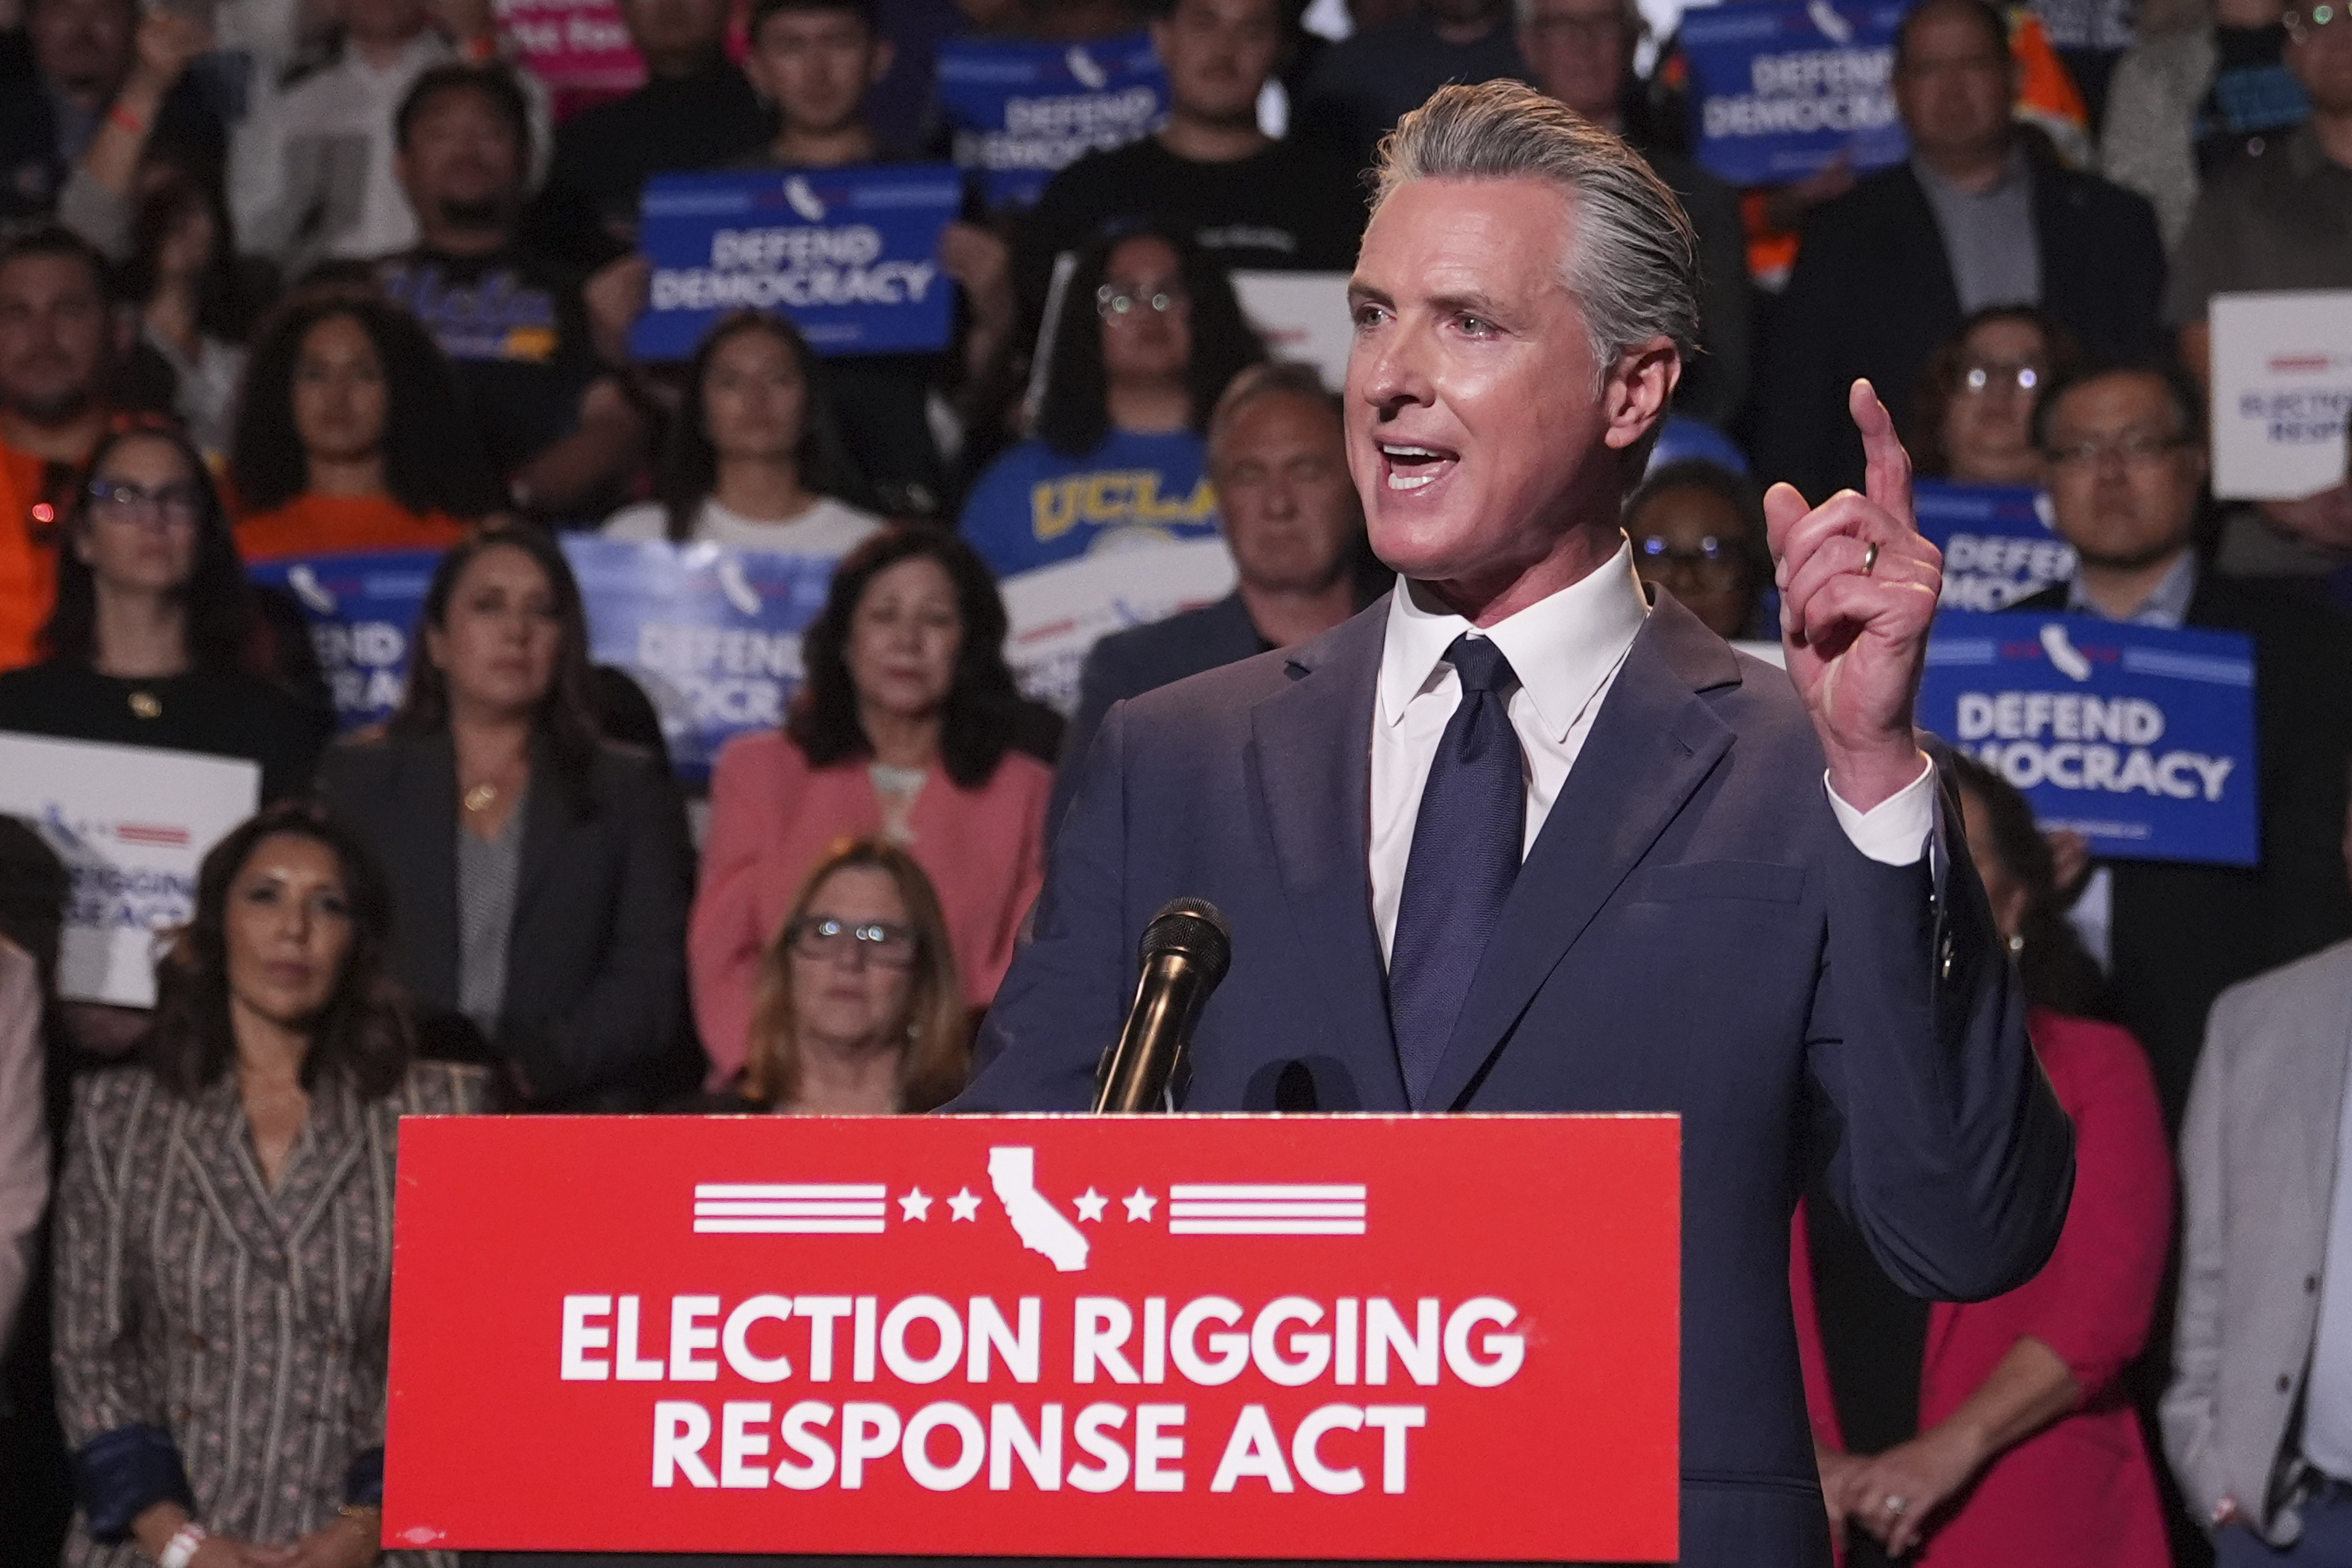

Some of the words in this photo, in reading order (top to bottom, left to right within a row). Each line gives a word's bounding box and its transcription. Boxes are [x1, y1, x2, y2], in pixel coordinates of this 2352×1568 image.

[712, 225, 881, 268] DEFEND
[651, 261, 937, 309] DEMOCRACY
[639, 624, 804, 677] DEFEN
[1956, 690, 2166, 747] DEFEND
[1959, 740, 2234, 801] OCRACY
[561, 1294, 1041, 1384] ELECTION
[1073, 1296, 1525, 1388] RIGGING
[652, 1400, 1187, 1492] RESPONSE
[1210, 1404, 1427, 1495] ACT
